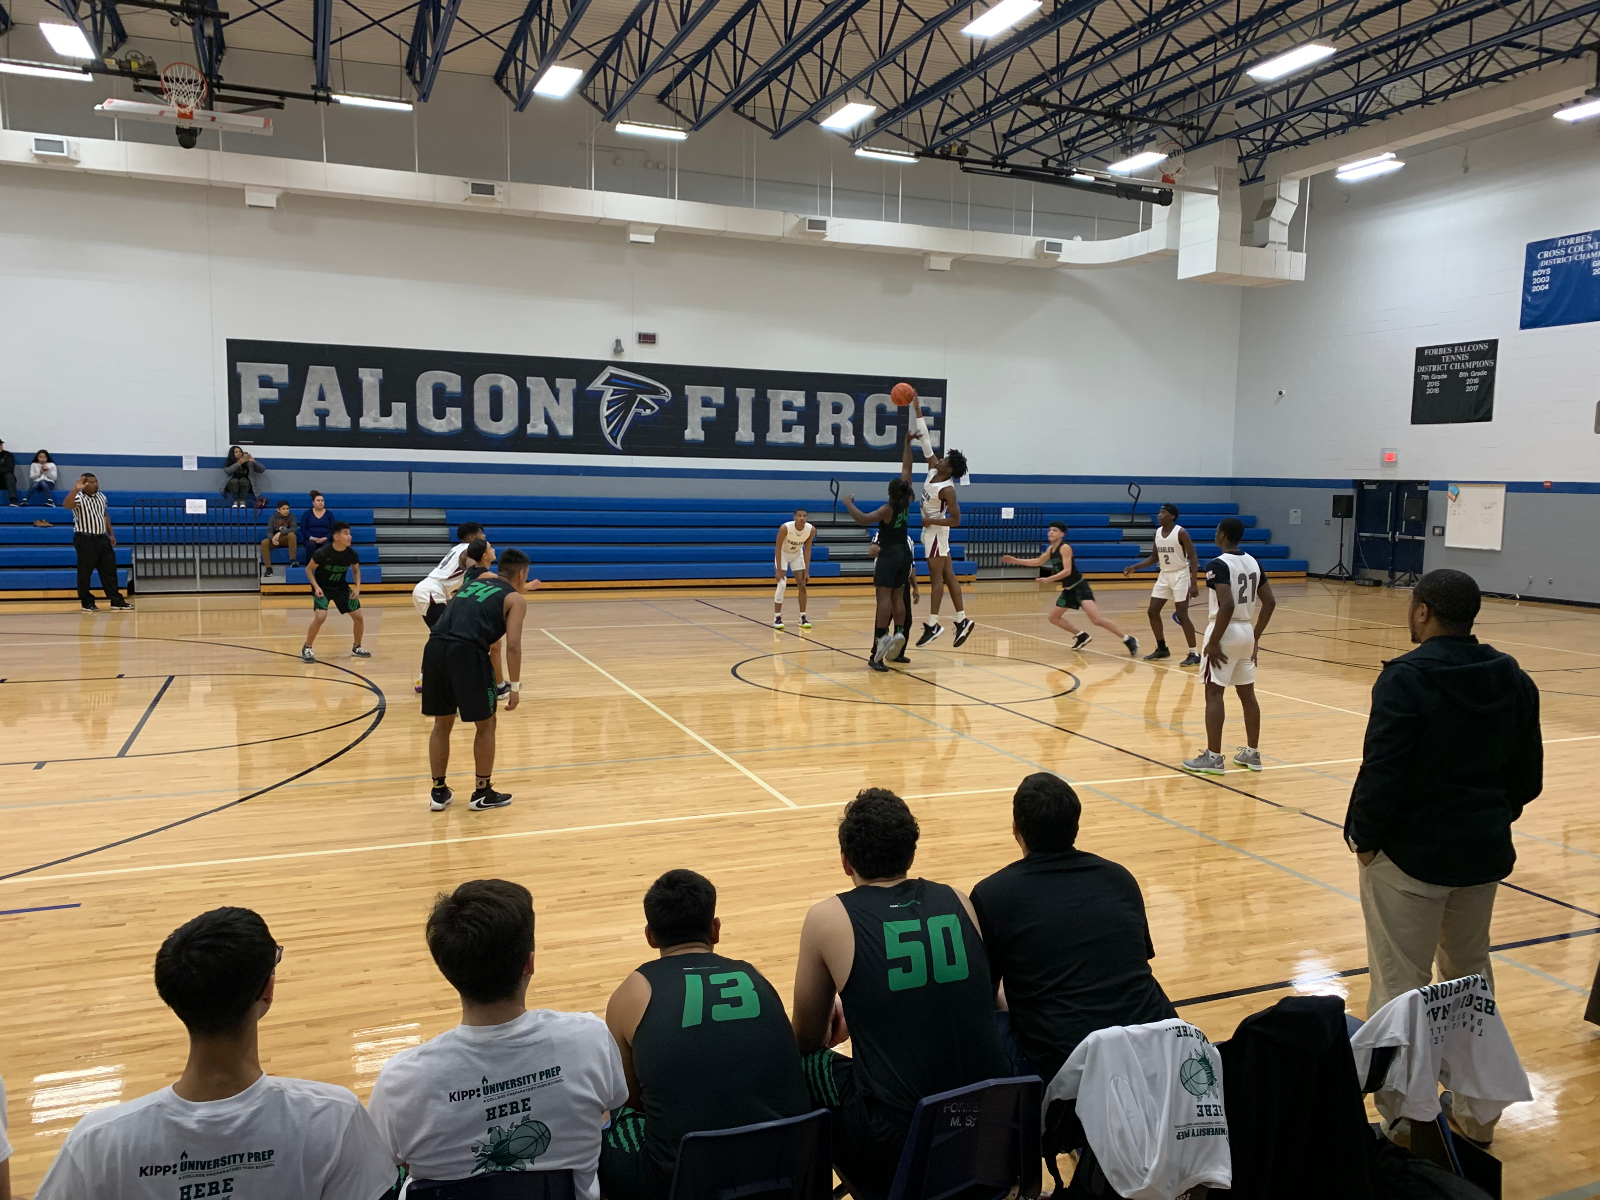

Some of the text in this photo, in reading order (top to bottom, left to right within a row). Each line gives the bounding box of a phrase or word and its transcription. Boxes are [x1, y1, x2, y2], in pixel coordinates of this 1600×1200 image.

[1558, 234, 1592, 246] FORBES
[1537, 248, 1566, 259] CROSS
[1540, 256, 1573, 266] DISTRICT
[1532, 268, 1551, 277] BOYS
[1532, 276, 1550, 285] 2003
[1532, 284, 1549, 292] 2004
[1424, 343, 1489, 356] FORBES FALCONS
[1441, 353, 1470, 363] TENNIS
[1417, 360, 1494, 373] DISTRICT CHAMPIONS
[236, 361, 943, 449] FALCON FIERCE
[1163, 554, 1171, 565] 2
[456, 582, 502, 603] 34
[1237, 572, 1258, 605] 21
[883, 914, 970, 992] 50
[681, 971, 761, 1028] 13
[482, 1073, 537, 1096] UNIVERSITY
[539, 1065, 562, 1081] PREP
[485, 1097, 532, 1122] HERE
[180, 1152, 245, 1172] UNIVERSITY
[247, 1149, 275, 1163] PREP
[179, 1178, 234, 1200] HERE
